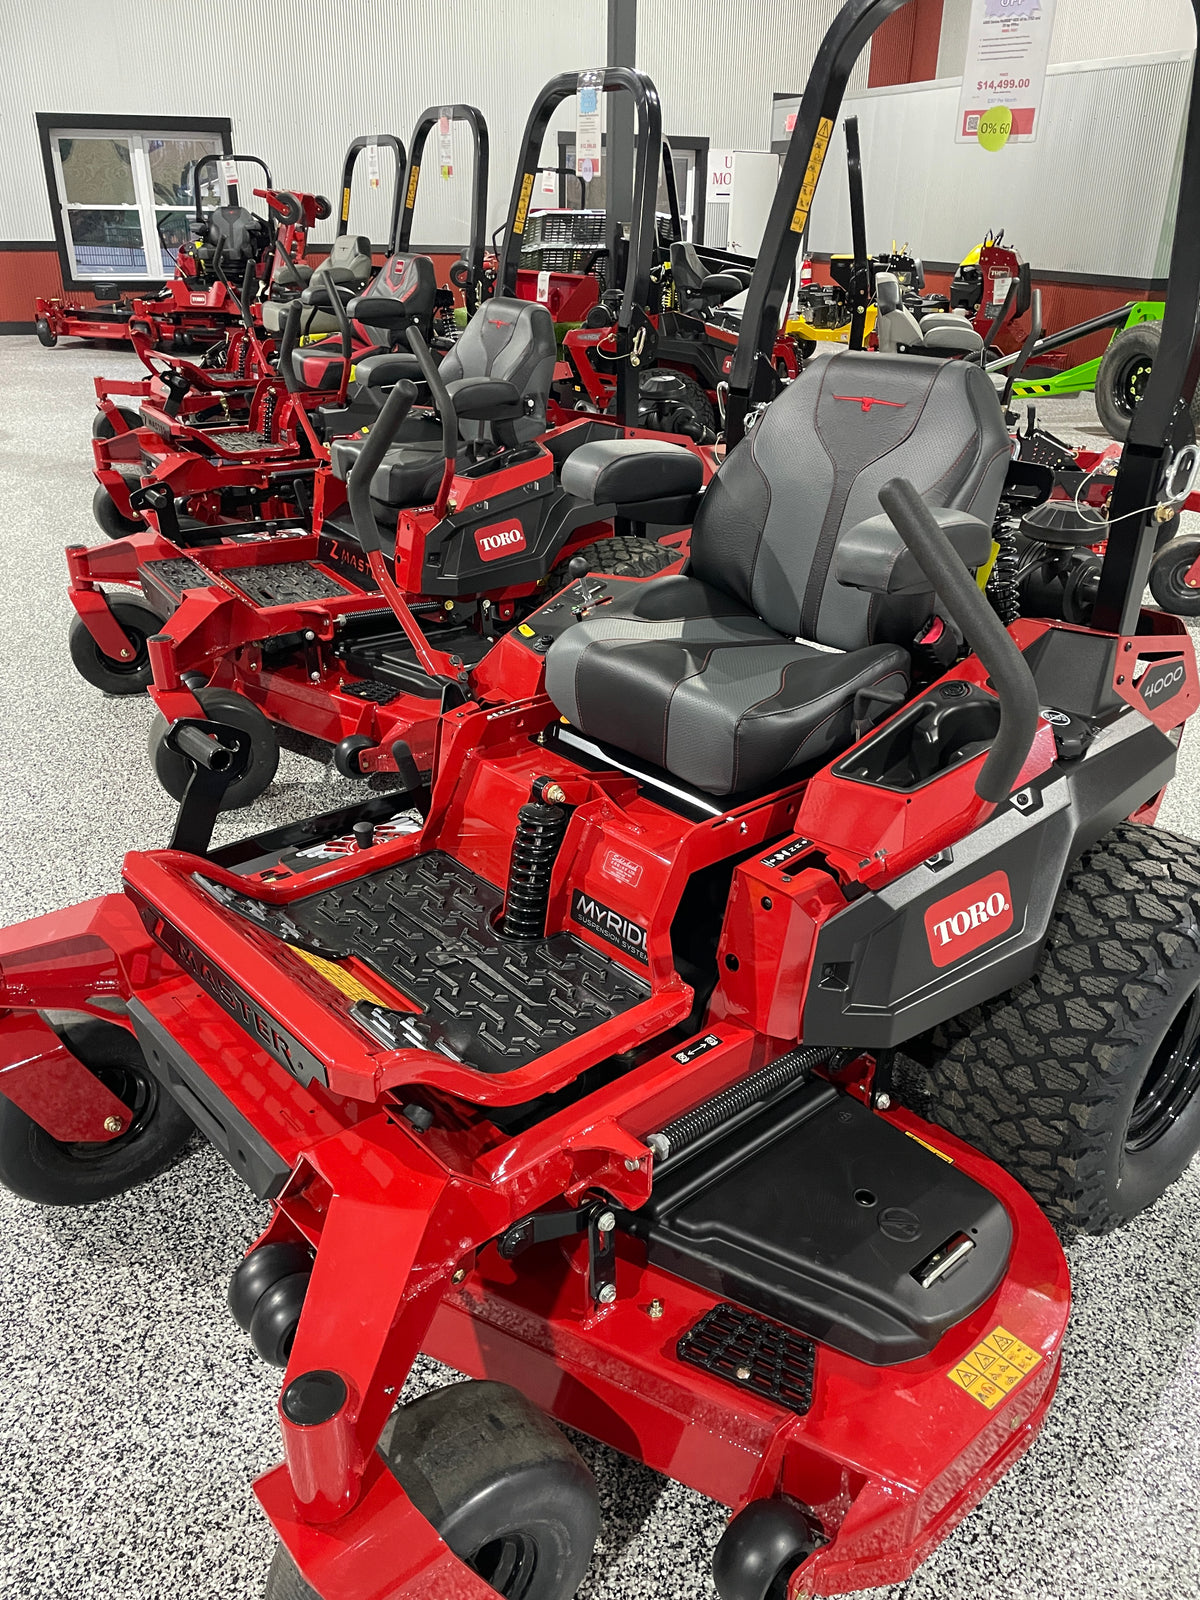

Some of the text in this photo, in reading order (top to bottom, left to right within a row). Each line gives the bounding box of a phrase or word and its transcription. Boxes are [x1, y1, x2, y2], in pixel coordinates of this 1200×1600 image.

[977, 78, 1030, 91] $14,499.00
[981, 123, 1010, 134] 0% 60
[480, 529, 521, 551] TORO
[329, 540, 374, 578] Z MAST
[1144, 665, 1184, 698] 4000
[578, 913, 620, 944] SUSPENSION
[933, 892, 1005, 946] TORO
[178, 940, 297, 1077] MASTER
